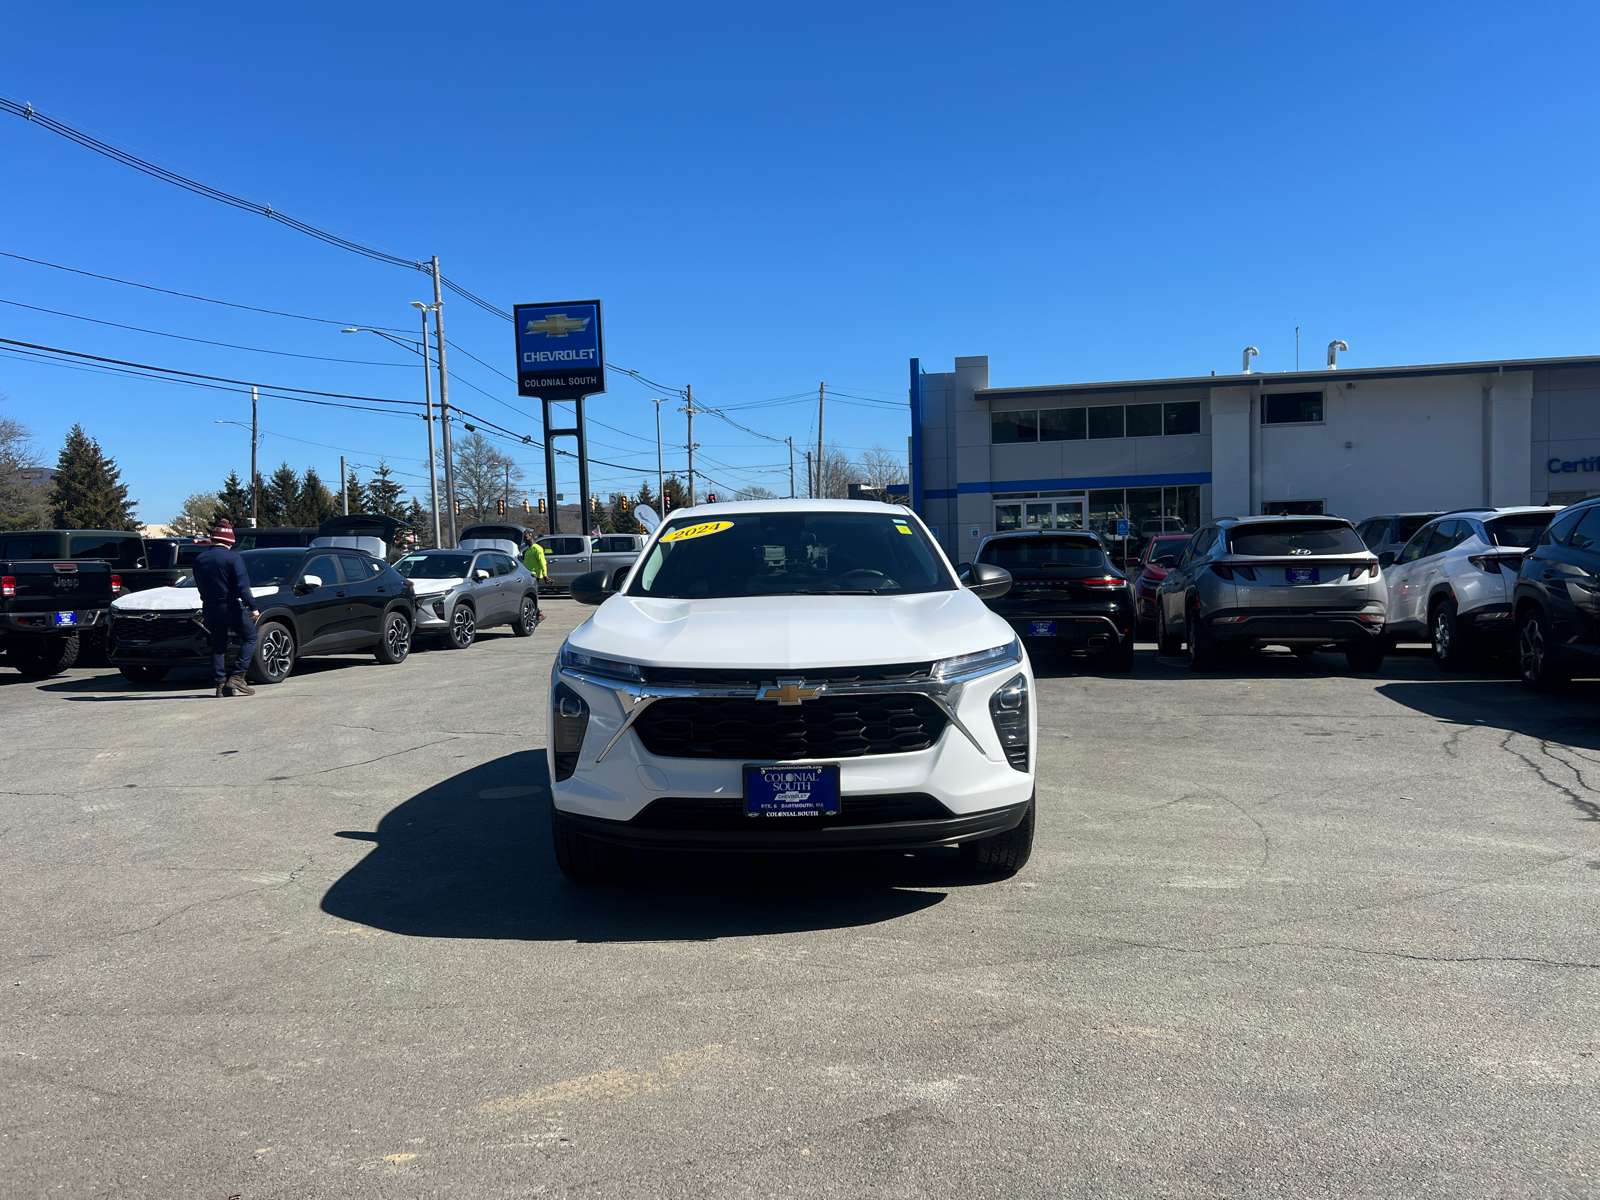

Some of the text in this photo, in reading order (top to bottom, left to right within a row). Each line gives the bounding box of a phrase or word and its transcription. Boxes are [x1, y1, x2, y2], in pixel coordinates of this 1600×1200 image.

[524, 348, 595, 362] CHEVROLET
[524, 376, 597, 388] COLONIAL SOUTH
[672, 522, 721, 540] 2024
[53, 576, 79, 588] Jeep
[764, 773, 819, 782] COLONIAL
[773, 782, 811, 791] SOUTH
